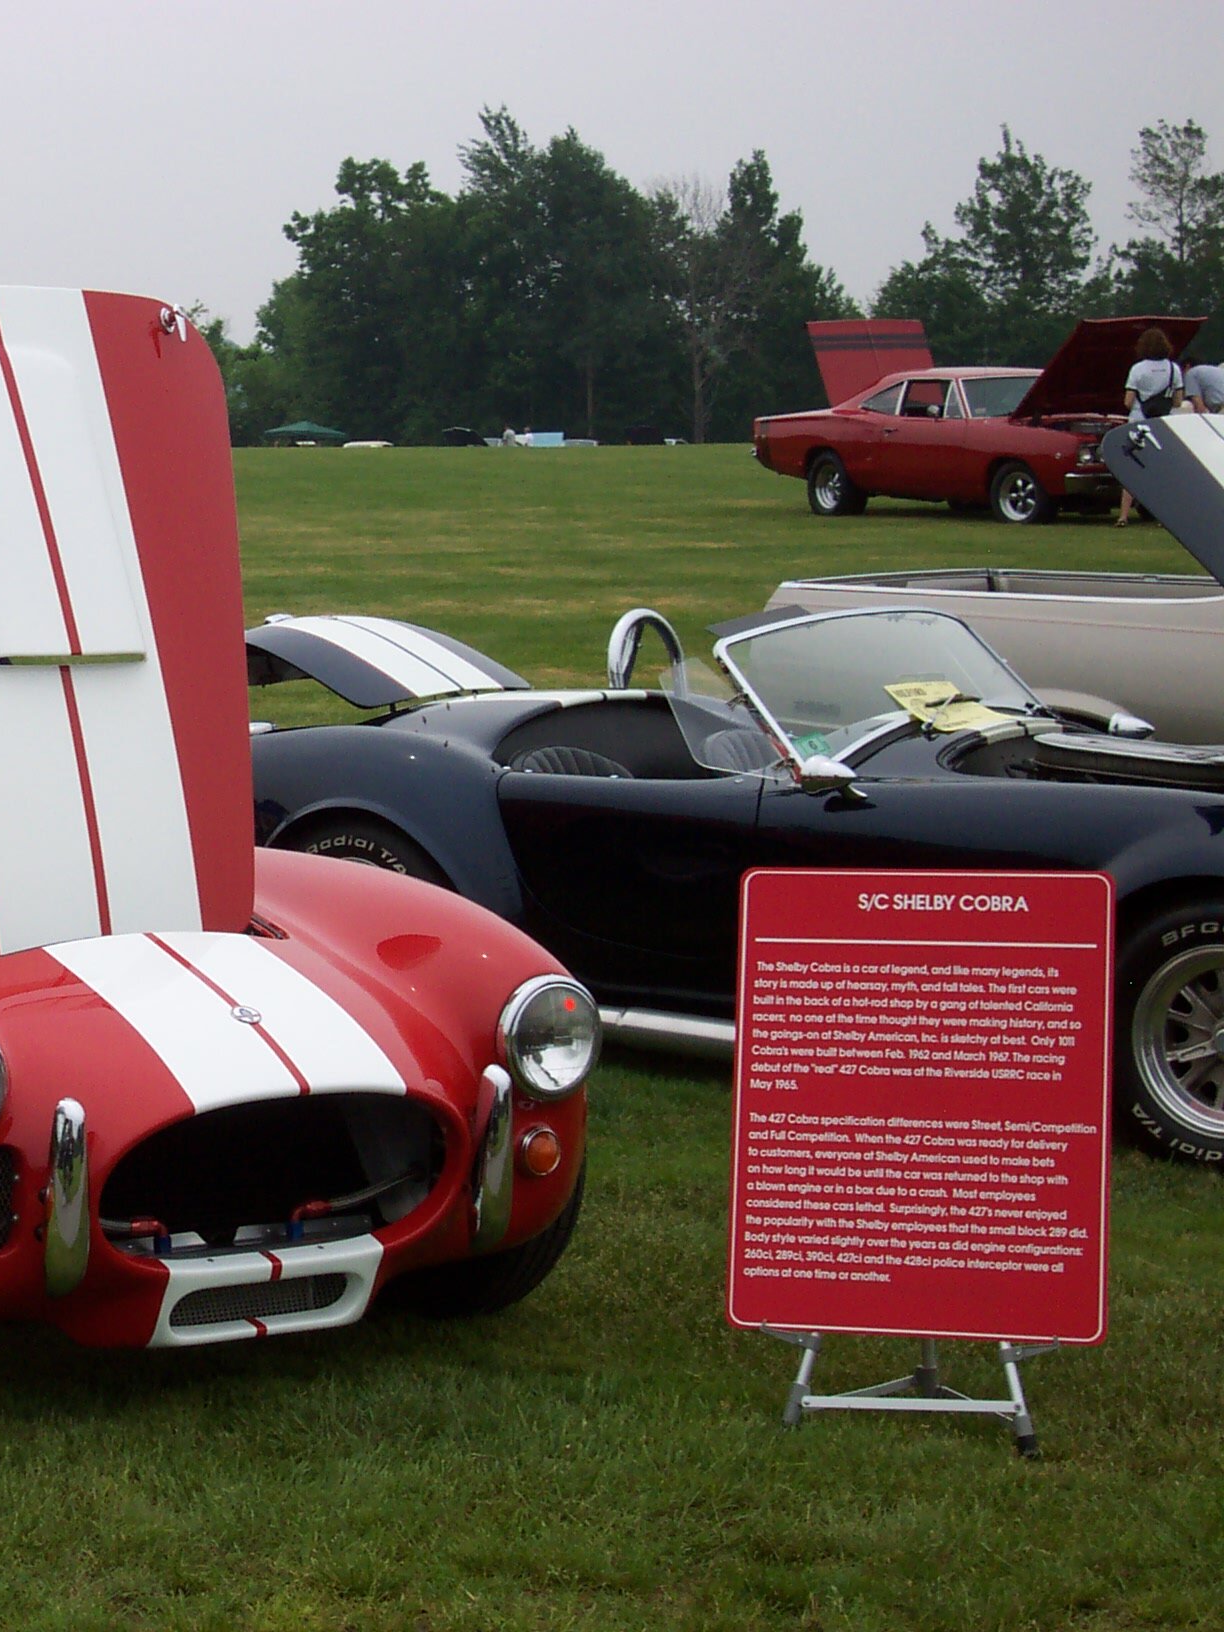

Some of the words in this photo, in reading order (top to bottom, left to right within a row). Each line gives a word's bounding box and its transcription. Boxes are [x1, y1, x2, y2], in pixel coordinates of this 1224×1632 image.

[857, 893, 889, 912] S/C
[892, 893, 955, 911] SHELBY
[959, 894, 1029, 912] COBRA
[1161, 921, 1224, 947] BFG
[775, 961, 809, 974] Shelby
[809, 961, 842, 973] Cobra
[890, 963, 929, 976] legend,
[930, 965, 952, 975] and
[971, 967, 1001, 978] many
[1001, 966, 1045, 979] legends,
[753, 977, 778, 990] story
[788, 979, 819, 989] made
[846, 979, 889, 993] hearsay,
[890, 981, 919, 993] myth,
[920, 981, 942, 992] and
[958, 982, 986, 993] tales.
[1027, 985, 1050, 995] cars
[1051, 986, 1077, 995] were
[752, 994, 775, 1005] built
[803, 995, 830, 1006] back
[851, 996, 889, 1008] hot-rod
[889, 997, 914, 1010] shop
[939, 1000, 967, 1012] gang
[979, 999, 1023, 1011] talented
[1024, 1000, 1074, 1012] California
[752, 1013, 786, 1023] racers;
[803, 1014, 824, 1023] one
[854, 1013, 878, 1024] time
[878, 1014, 918, 1027] thought
[918, 1015, 941, 1028] they
[942, 1018, 968, 1027] were
[968, 1017, 1008, 1030] making
[1008, 1017, 1045, 1030] history,
[1046, 1019, 1068, 1029] and
[769, 1029, 820, 1041] goings-on
[832, 1029, 866, 1043] Shelby
[867, 1031, 920, 1043] American,
[950, 1033, 988, 1046] sketchy
[1001, 1034, 1026, 1045] best.
[1030, 1035, 1055, 1048] Only
[751, 1044, 789, 1056] Cobra's
[789, 1048, 815, 1057] were
[815, 1046, 838, 1057] built
[838, 1047, 884, 1058] between
[884, 1048, 906, 1059] Feb.
[908, 1048, 930, 1060] 1962
[931, 1050, 952, 1060] and
[953, 1050, 986, 1061] March
[988, 1051, 1011, 1062] 1967.
[1032, 1053, 1066, 1066] racing
[750, 1061, 781, 1073] debut
[858, 1064, 891, 1076] Cobra
[891, 1067, 913, 1076] was
[944, 1067, 990, 1079] Riverside
[991, 1068, 1025, 1080] USRRC
[1026, 1071, 1051, 1081] race
[750, 1078, 773, 1091] May
[774, 1079, 798, 1090] 1965.
[786, 1113, 820, 1125] Cobra
[820, 1115, 886, 1127] specification
[886, 1116, 944, 1129] differences
[944, 1120, 970, 1130] were
[970, 1119, 1003, 1132] Street,
[748, 1129, 769, 1140] and
[786, 1130, 851, 1143] Competition.
[854, 1132, 884, 1144] When
[922, 1134, 955, 1146] Cobra
[956, 1138, 977, 1147] was
[978, 1137, 1009, 1150] ready
[1026, 1138, 1068, 1152] delivery
[759, 1147, 813, 1159] customers,
[814, 1150, 862, 1161] everyone
[875, 1150, 909, 1164] Shelby
[910, 1151, 961, 1164] American
[962, 1154, 988, 1165] used
[1001, 1155, 1031, 1167] make
[1032, 1156, 1055, 1167] bets
[761, 1163, 784, 1174] how
[783, 1164, 807, 1178] long
[815, 1166, 846, 1177] would
[863, 1167, 885, 1178] until
[922, 1171, 943, 1181] was
[944, 1170, 988, 1182] returned
[1019, 1173, 1045, 1186] shop
[1046, 1174, 1068, 1185] with
[755, 1180, 786, 1191] blown
[787, 1182, 822, 1195] engine
[854, 1184, 874, 1195] box
[875, 1185, 896, 1196] due
[918, 1187, 948, 1198] crash.
[952, 1187, 978, 1199] Most
[979, 1190, 1036, 1203] employees
[745, 1197, 802, 1210] considered
[802, 1199, 831, 1211] these
[832, 1202, 854, 1212] cars
[889, 1202, 948, 1217] Surprisingly,
[968, 1205, 993, 1217] 427's
[994, 1208, 1024, 1218] never
[1024, 1208, 1067, 1221] enjoyed
[763, 1216, 814, 1229] popularity
[815, 1217, 837, 1228] with
[856, 1218, 890, 1232] Shelby
[890, 1220, 947, 1234] employees
[948, 1222, 969, 1234] that
[989, 1225, 1016, 1235] small
[1017, 1225, 1047, 1237] block
[1048, 1226, 1068, 1238] 289
[744, 1230, 771, 1244] Body
[771, 1232, 796, 1245] style
[797, 1234, 830, 1245] varied
[830, 1235, 865, 1248] slightly
[866, 1238, 889, 1247] over
[908, 1240, 937, 1251] years
[970, 1241, 1006, 1254] engine
[1007, 1243, 1083, 1256] configurations:
[836, 1252, 862, 1264] 427ci
[863, 1254, 884, 1265] and
[903, 1255, 932, 1267] 428ci
[932, 1257, 966, 1269] police
[966, 1258, 1022, 1272] interceptor
[1023, 1263, 1049, 1272] were
[743, 1265, 780, 1278] options
[814, 1268, 837, 1280] time
[849, 1271, 891, 1282] another.
